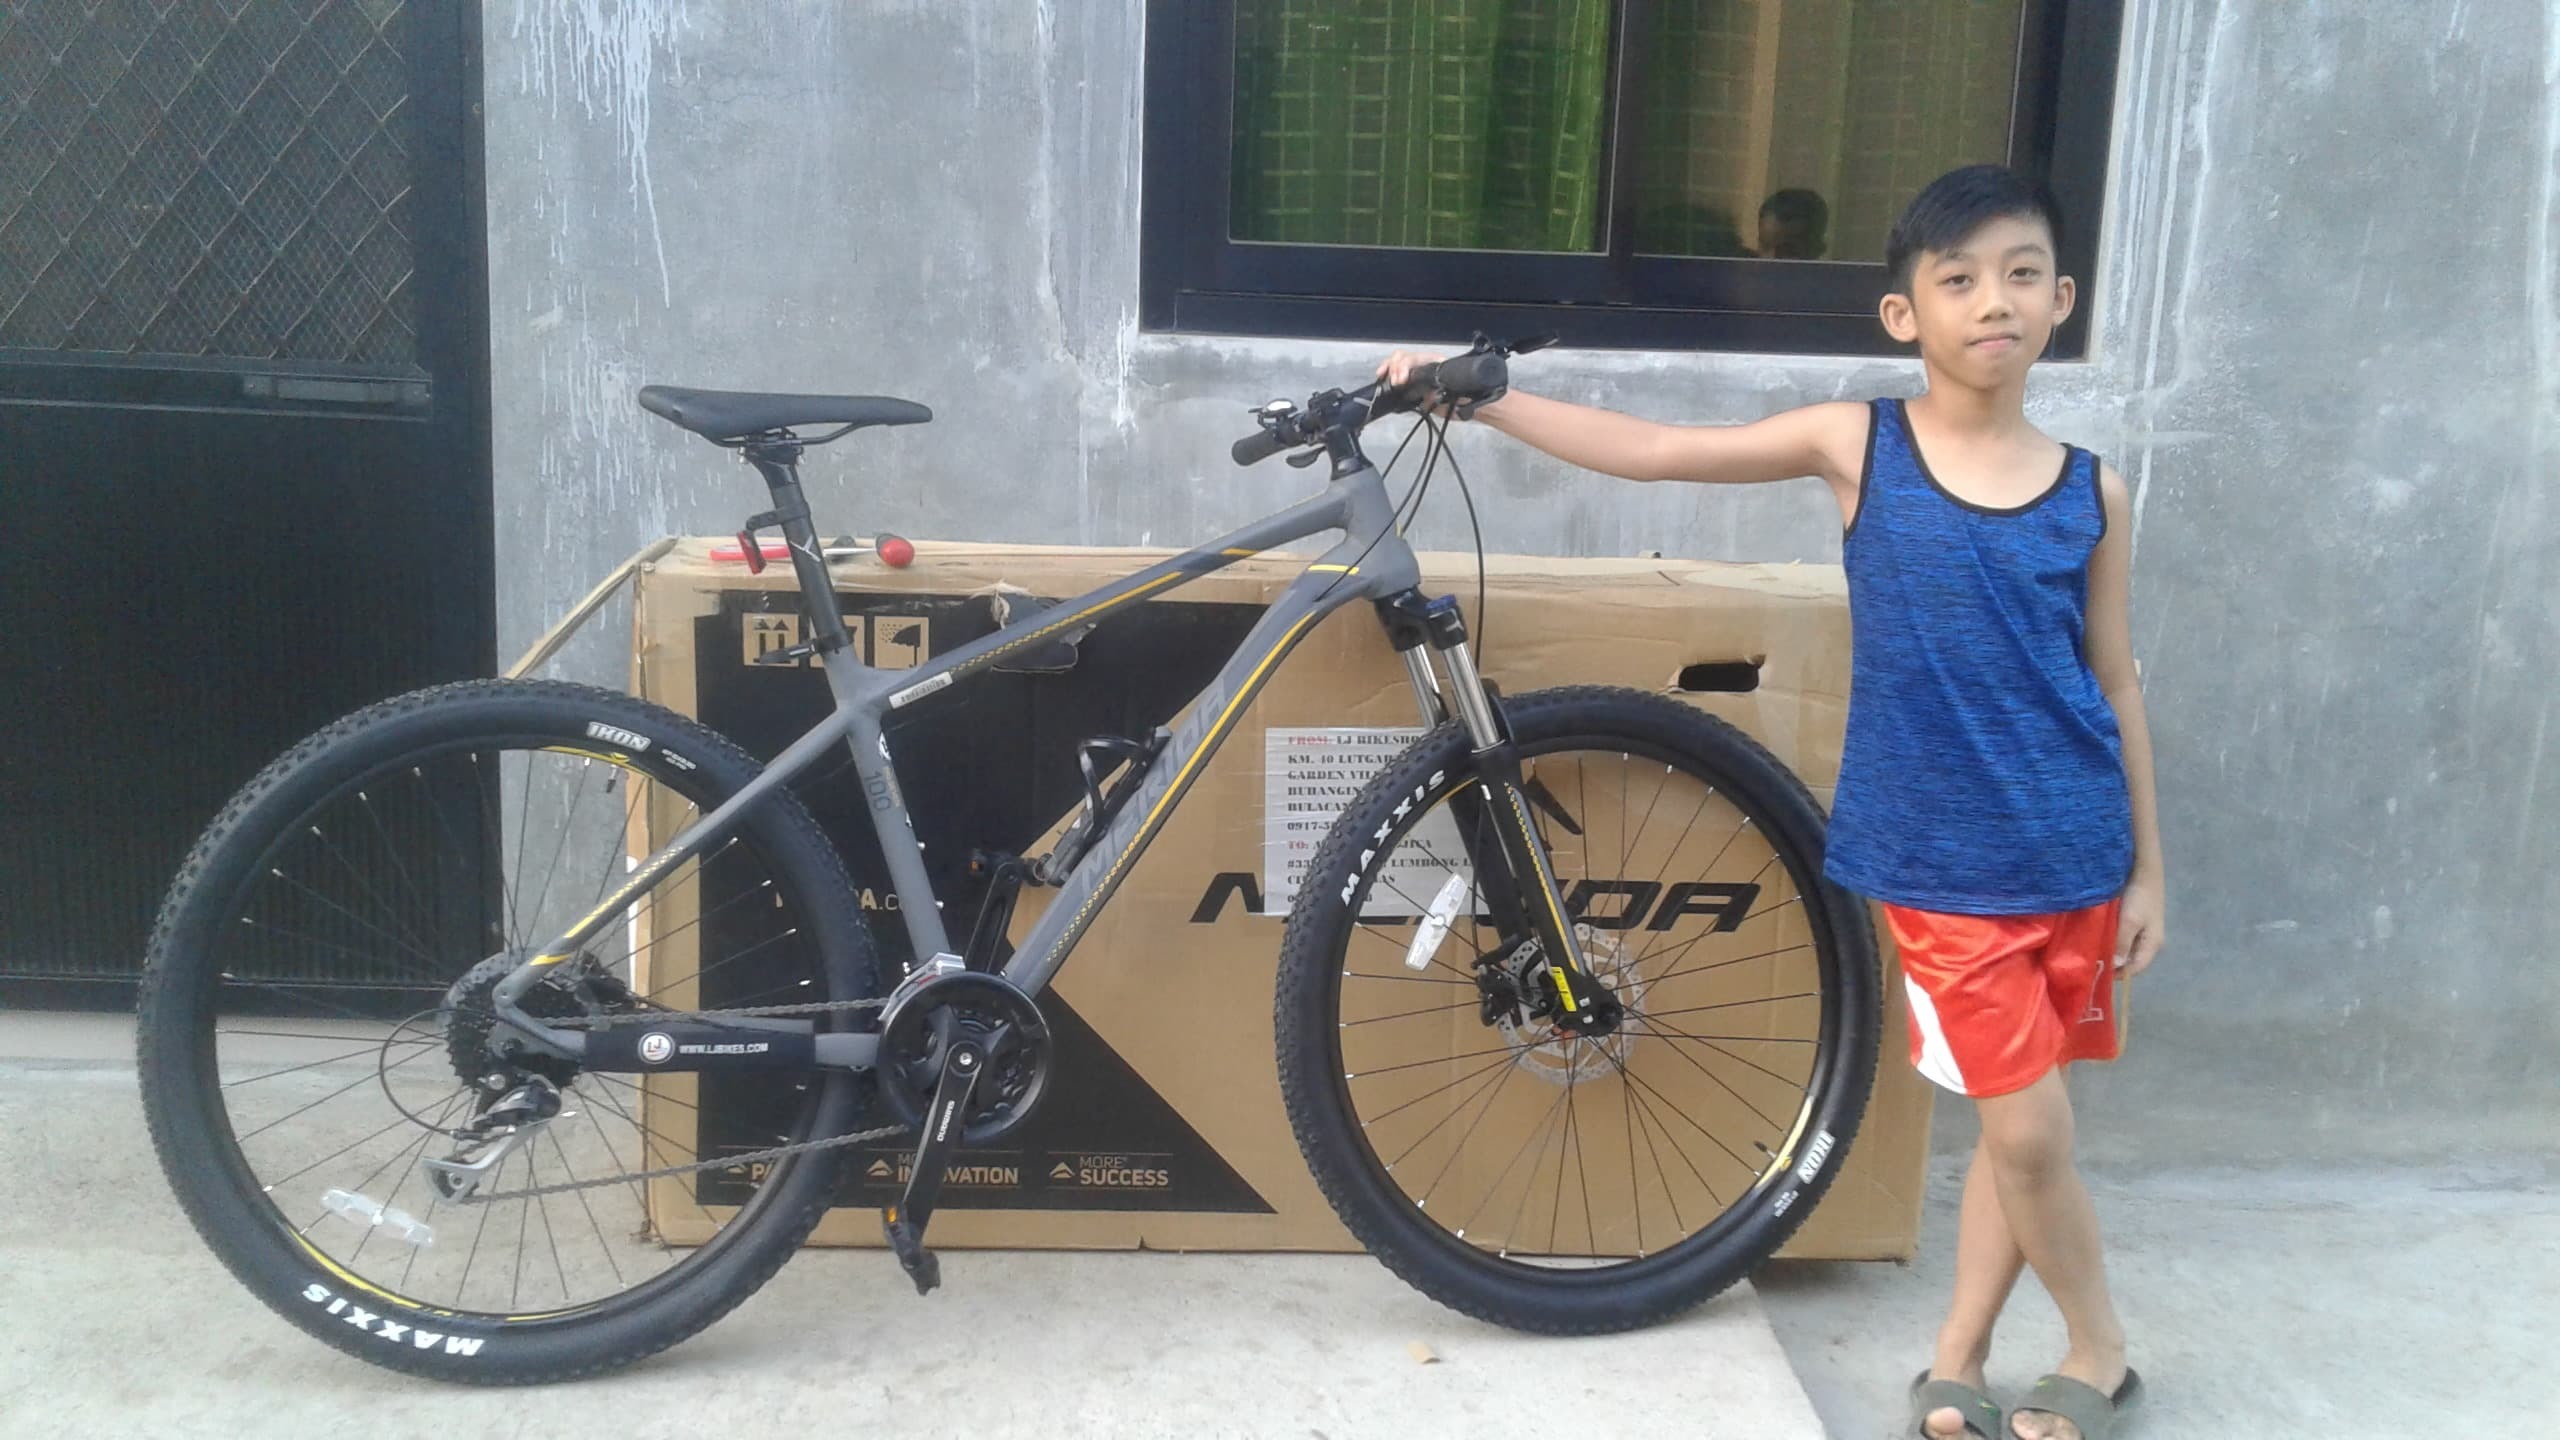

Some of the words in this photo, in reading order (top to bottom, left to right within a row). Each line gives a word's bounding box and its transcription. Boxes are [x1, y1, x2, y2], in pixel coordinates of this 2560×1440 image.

[587, 722, 651, 752] IKON
[1288, 770, 1346, 780] GARDEN
[1341, 770, 1445, 907] MAXXIS
[1080, 1169, 1169, 1186] SUCCESS
[1798, 1130, 1836, 1184] IKON
[302, 1283, 485, 1357] MAXXIS
